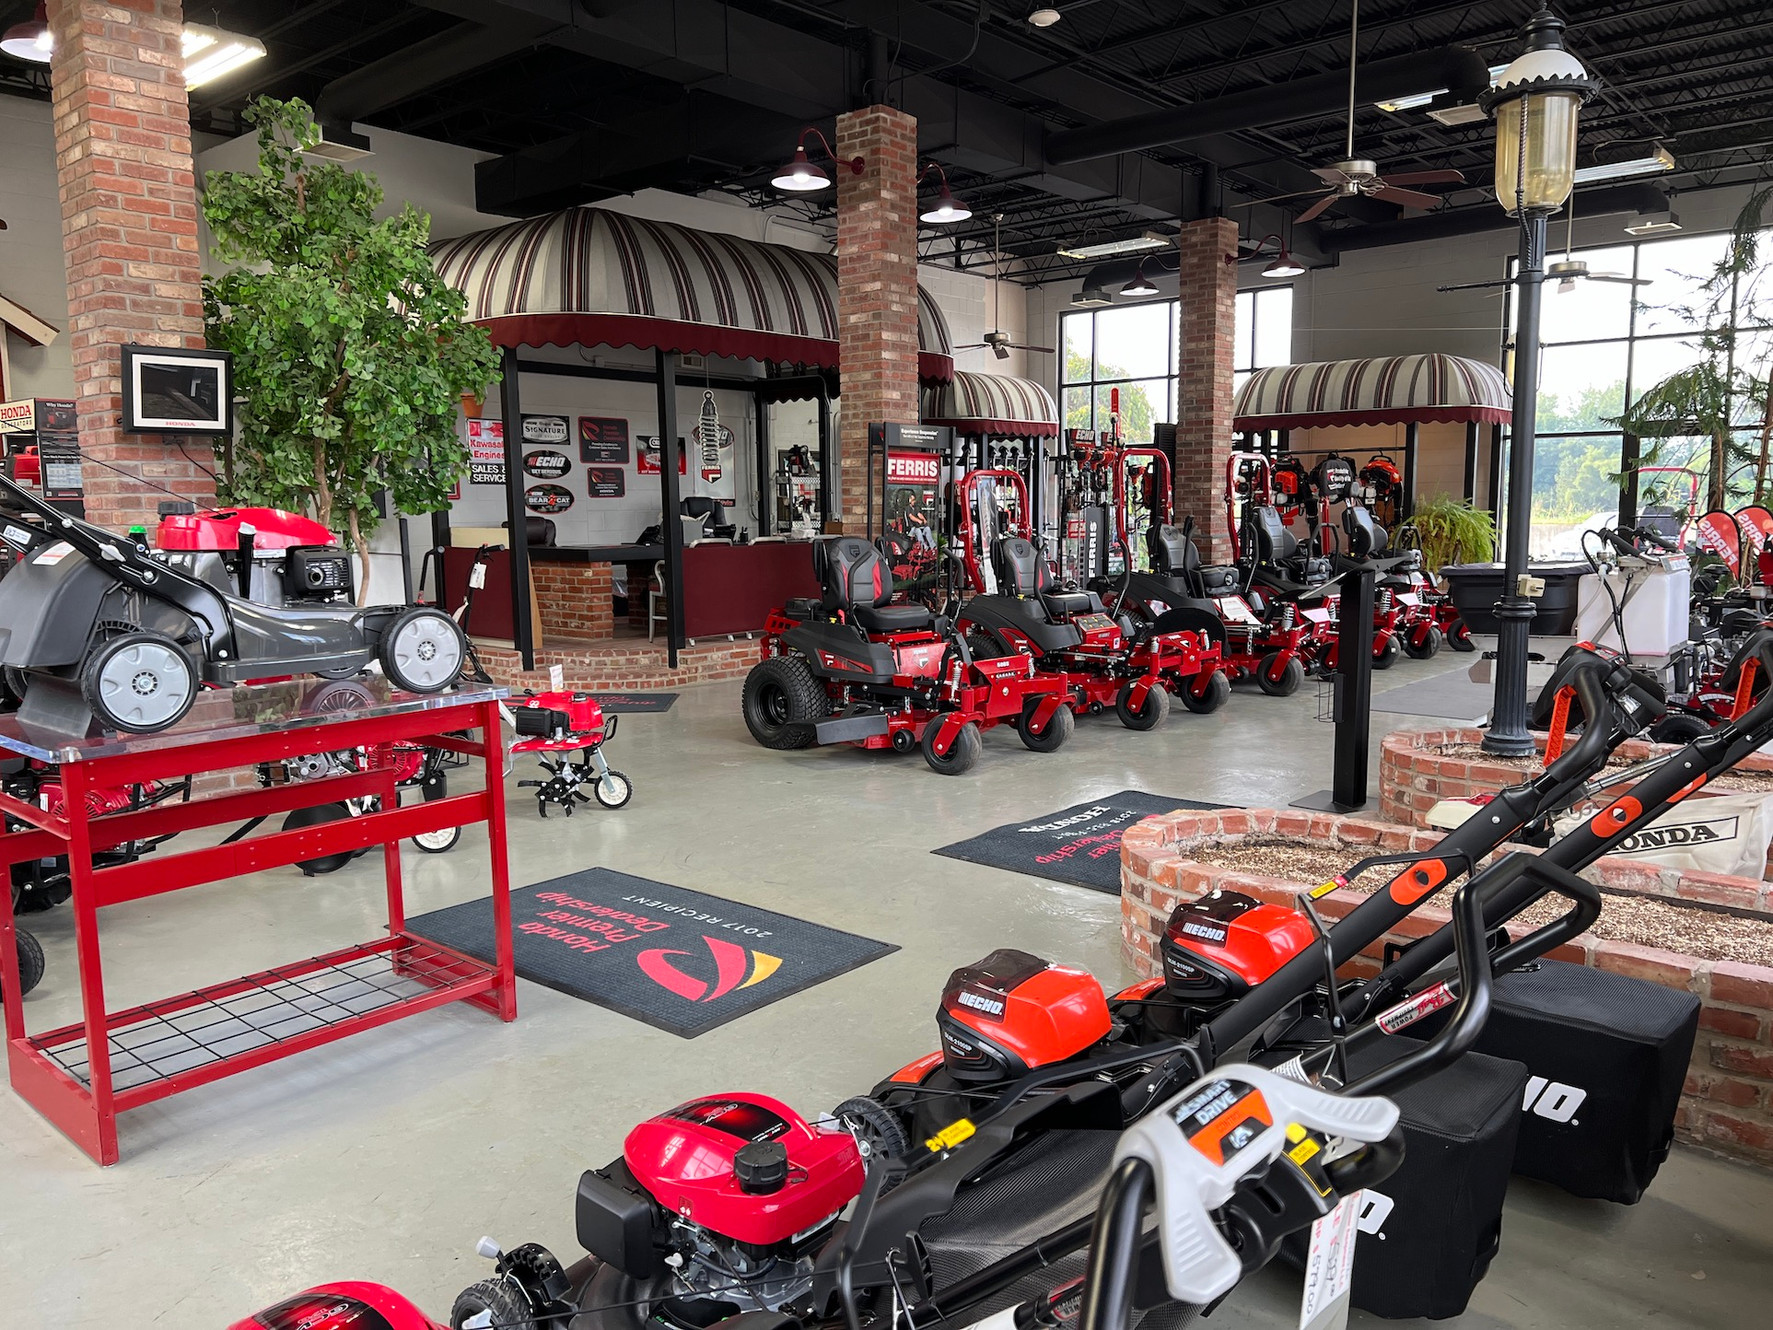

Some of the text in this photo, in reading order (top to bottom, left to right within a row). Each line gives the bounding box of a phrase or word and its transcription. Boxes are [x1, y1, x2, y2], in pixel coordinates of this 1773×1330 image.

[0, 405, 32, 420] HONDA
[1075, 429, 1095, 440] ECHO
[472, 464, 499, 474] SALES
[535, 456, 566, 467] ECHO
[887, 458, 938, 477] FERRIS
[1088, 521, 1097, 578] FERRIS
[1018, 805, 1111, 833] HONDA
[1612, 825, 1719, 851] ONDA
[535, 891, 671, 933] Dealership
[622, 894, 773, 939] 2017 RECIPIENT
[518, 921, 611, 954] Honda
[536, 910, 642, 943] Premier
[1191, 924, 1226, 941] ECHO
[967, 994, 1003, 1015] ECHO
[1391, 1014, 1414, 1029] POWER
[1195, 1090, 1237, 1126] DRIVE
